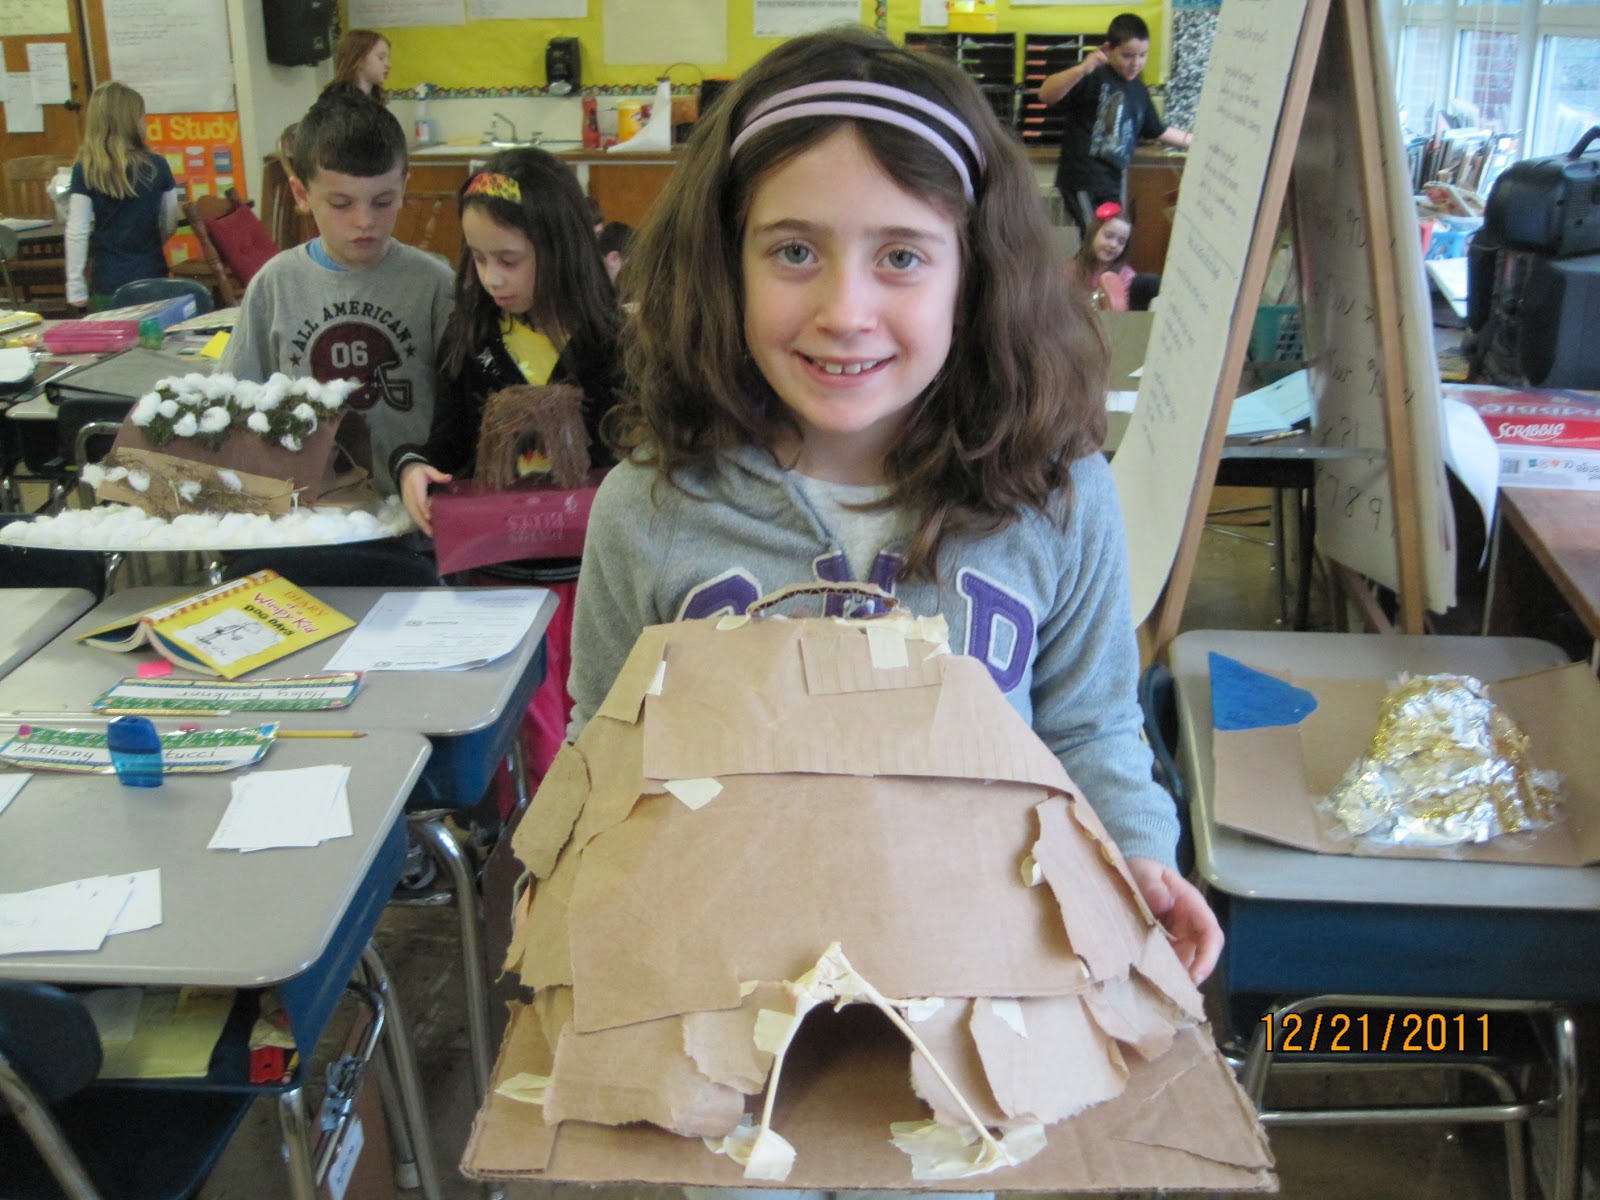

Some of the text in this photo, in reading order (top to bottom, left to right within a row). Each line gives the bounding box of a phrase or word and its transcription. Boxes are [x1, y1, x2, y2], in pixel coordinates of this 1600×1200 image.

[170, 116, 238, 143] Study
[291, 301, 412, 352] ALL AMERICAN
[330, 340, 369, 369] 06
[243, 605, 295, 636] DOG DAYS
[254, 592, 294, 619] Wimpy
[292, 617, 320, 634] Kid
[14, 742, 94, 763] Anthony
